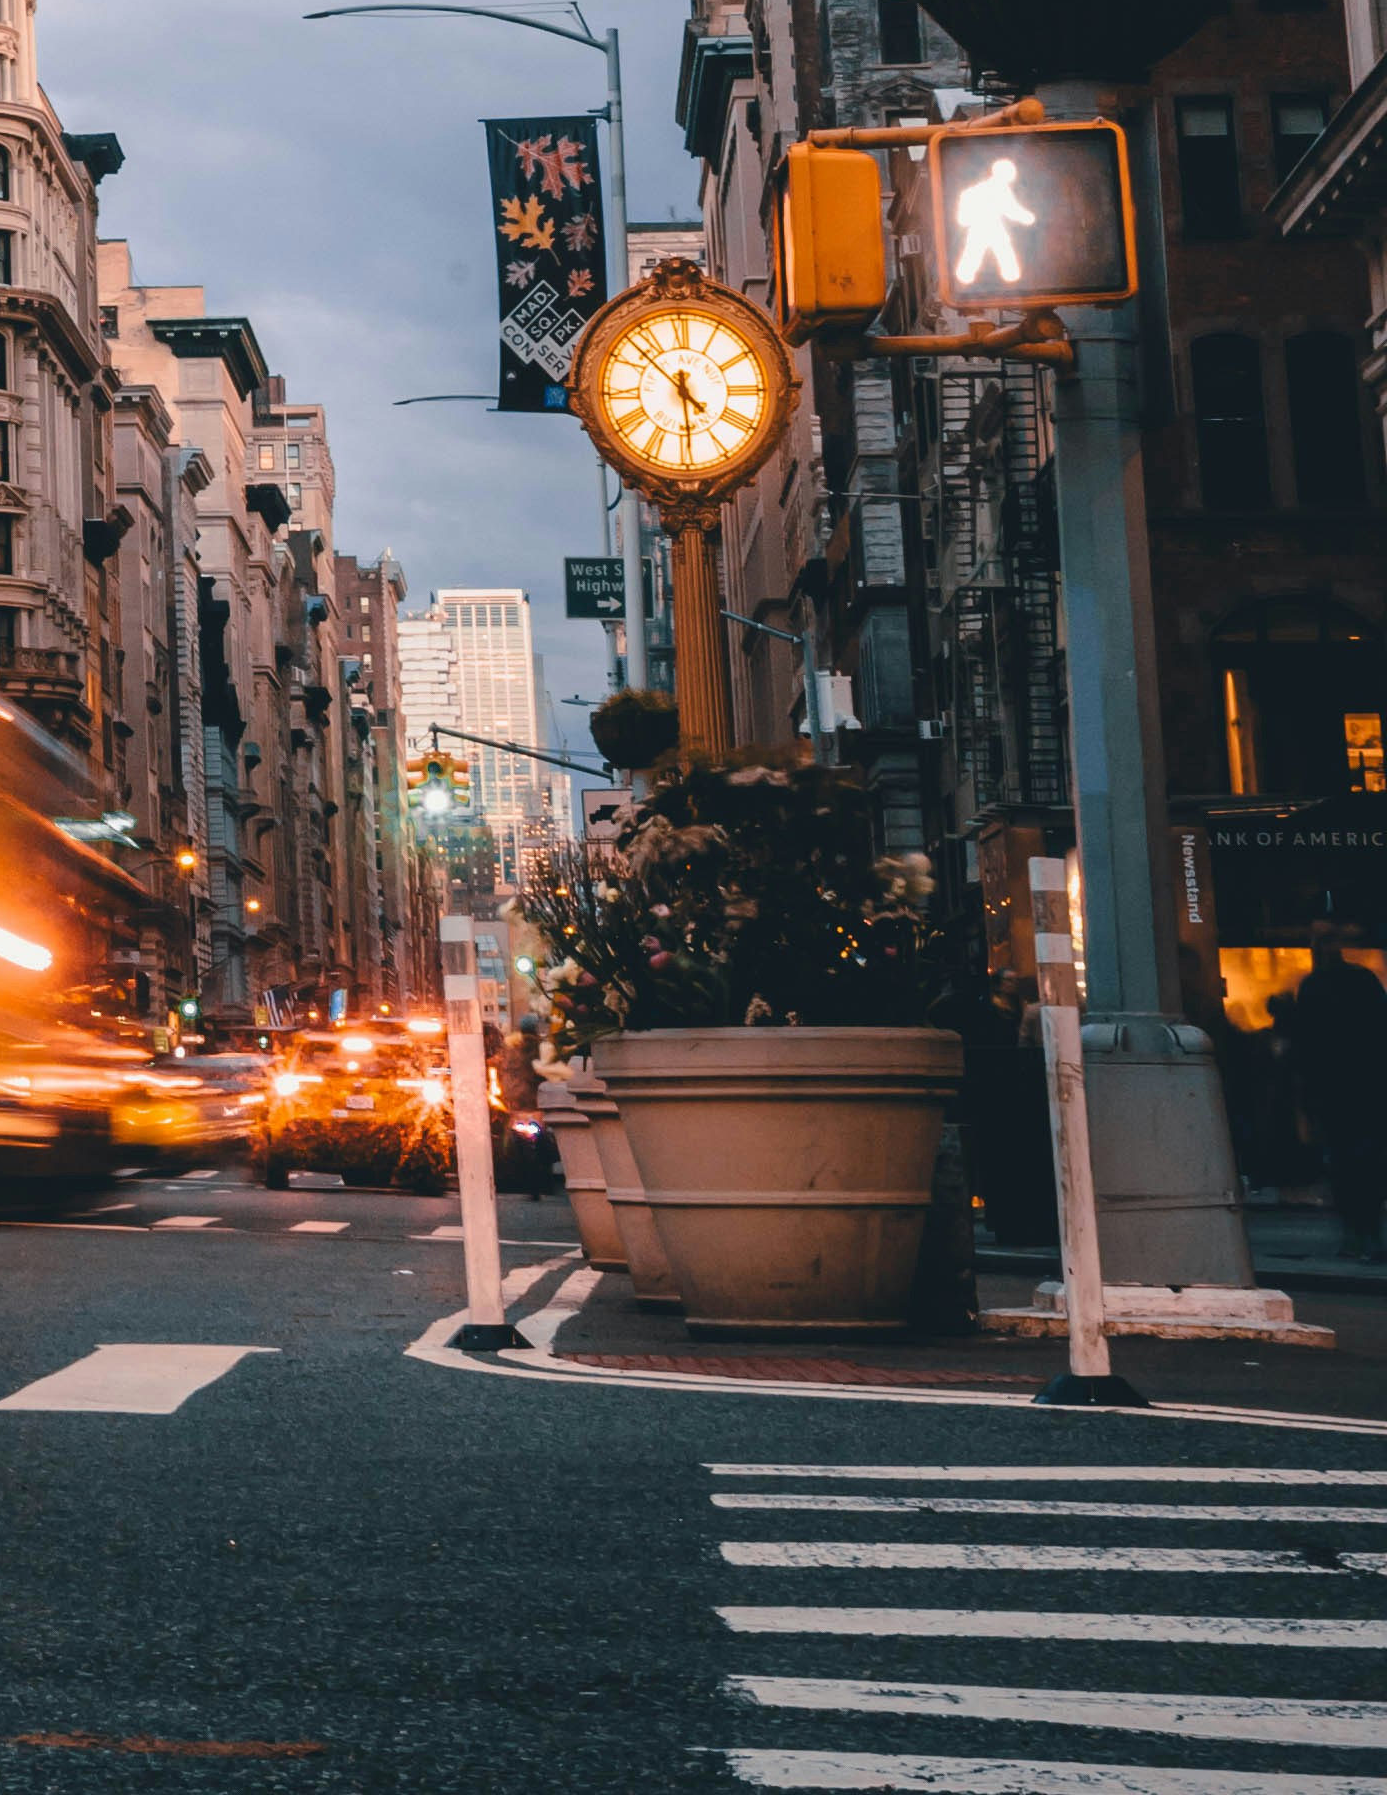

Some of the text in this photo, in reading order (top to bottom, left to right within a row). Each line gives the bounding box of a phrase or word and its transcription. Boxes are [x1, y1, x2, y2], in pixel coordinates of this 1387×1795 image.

[515, 291, 552, 324] MAD.
[530, 317, 557, 339] SQ.
[554, 322, 581, 342] PK.
[503, 325, 534, 356] CON
[538, 345, 565, 373] SER
[653, 410, 719, 430] BUIING
[570, 564, 607, 577] West
[576, 579, 625, 596] Highw
[1256, 831, 1284, 846] OF
[1292, 831, 1386, 847] AMERIC
[1181, 834, 1204, 924] Newsstand
